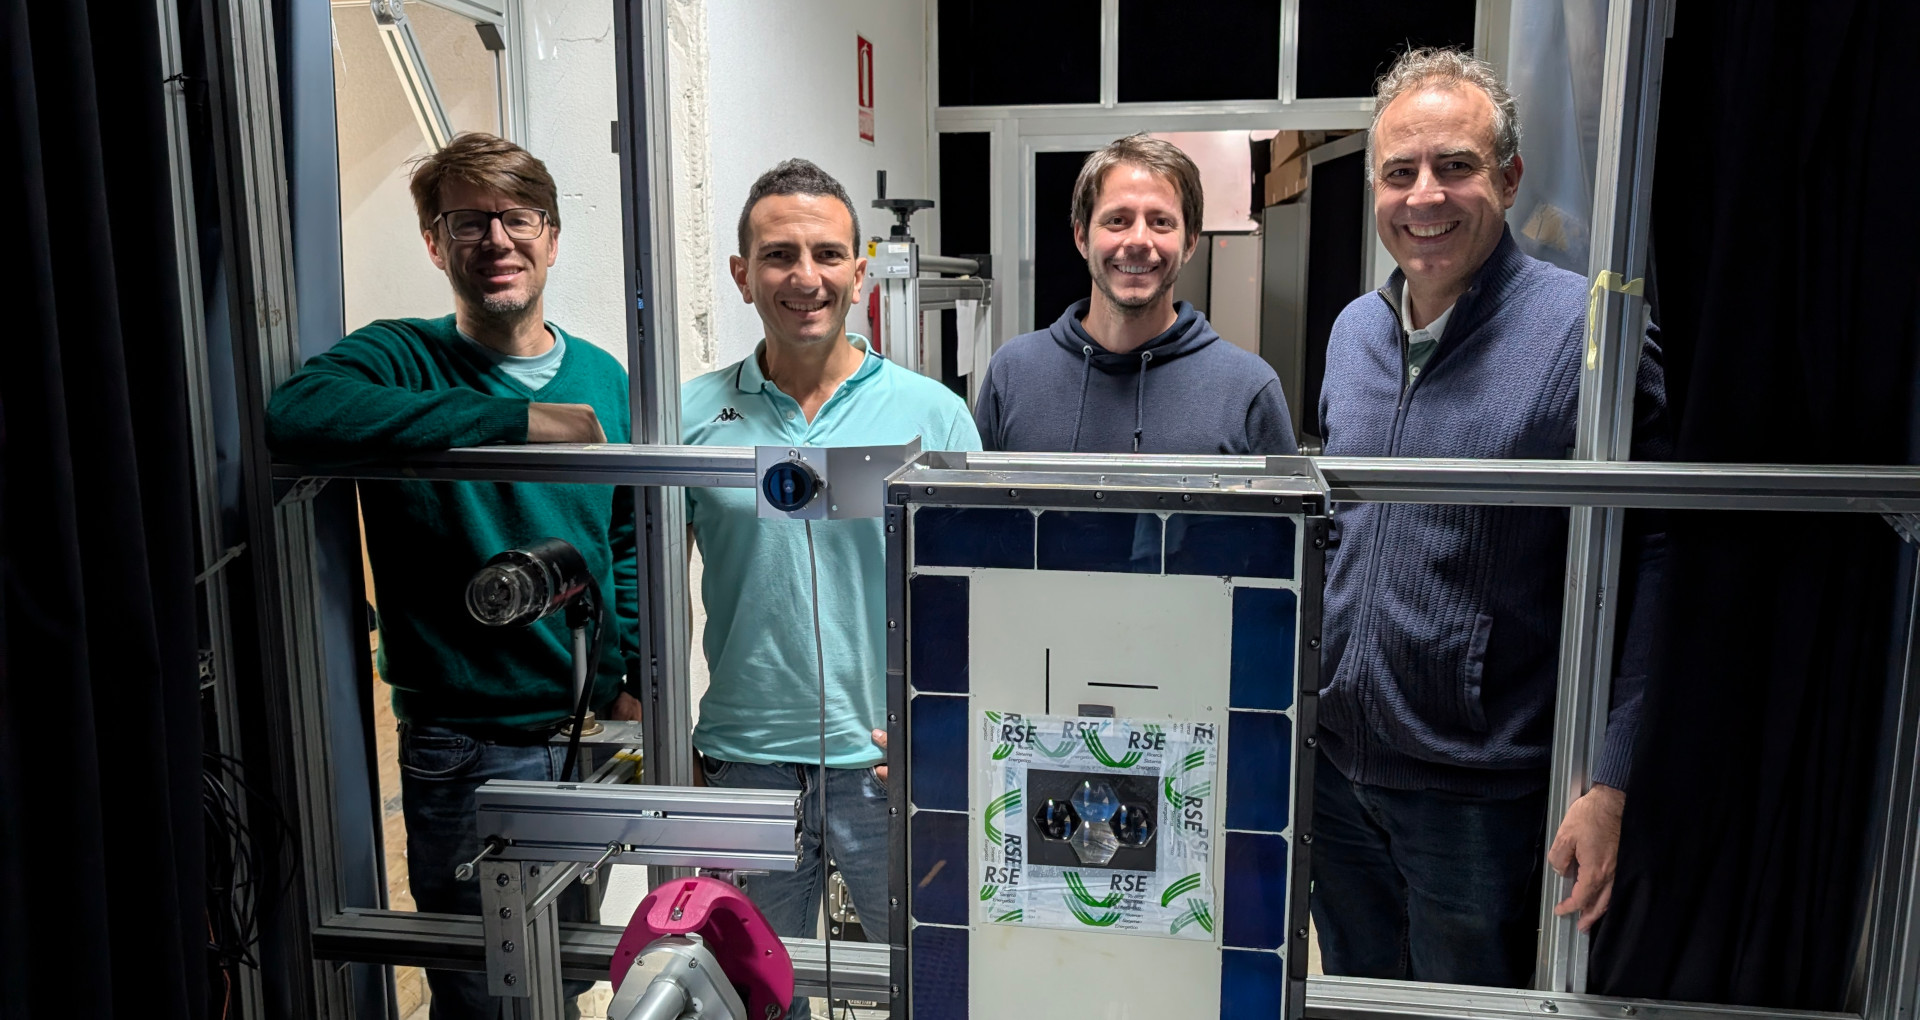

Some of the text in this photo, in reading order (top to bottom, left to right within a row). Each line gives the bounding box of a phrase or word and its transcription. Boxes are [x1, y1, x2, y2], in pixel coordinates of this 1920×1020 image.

[1001, 724, 1037, 743] RSE
[1128, 731, 1166, 750] RSE
[1184, 795, 1204, 832] RSE
[1004, 833, 1022, 867] RSE
[984, 866, 1020, 885] RSE
[1110, 874, 1147, 892] RSE
